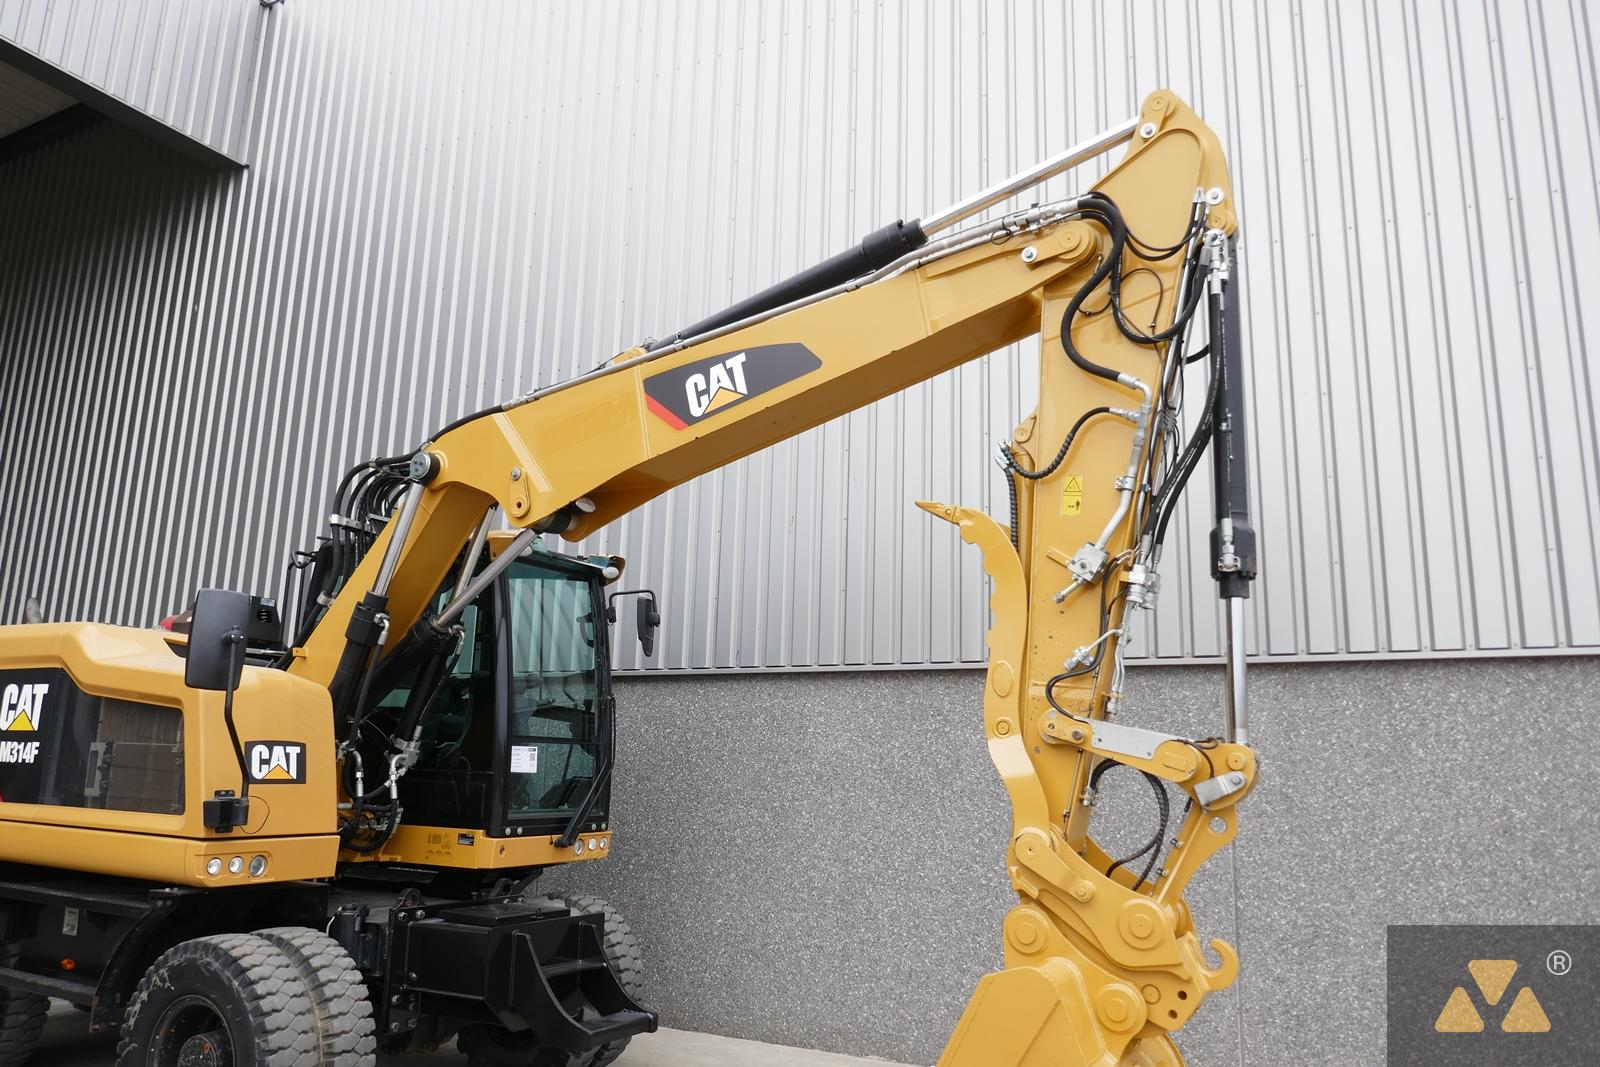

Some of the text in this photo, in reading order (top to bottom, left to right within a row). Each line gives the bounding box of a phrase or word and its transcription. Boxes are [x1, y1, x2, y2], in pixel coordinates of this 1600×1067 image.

[685, 352, 748, 417] CAT
[0, 683, 49, 731] CAT
[0, 741, 40, 763] M314F
[251, 744, 301, 780] CAT
